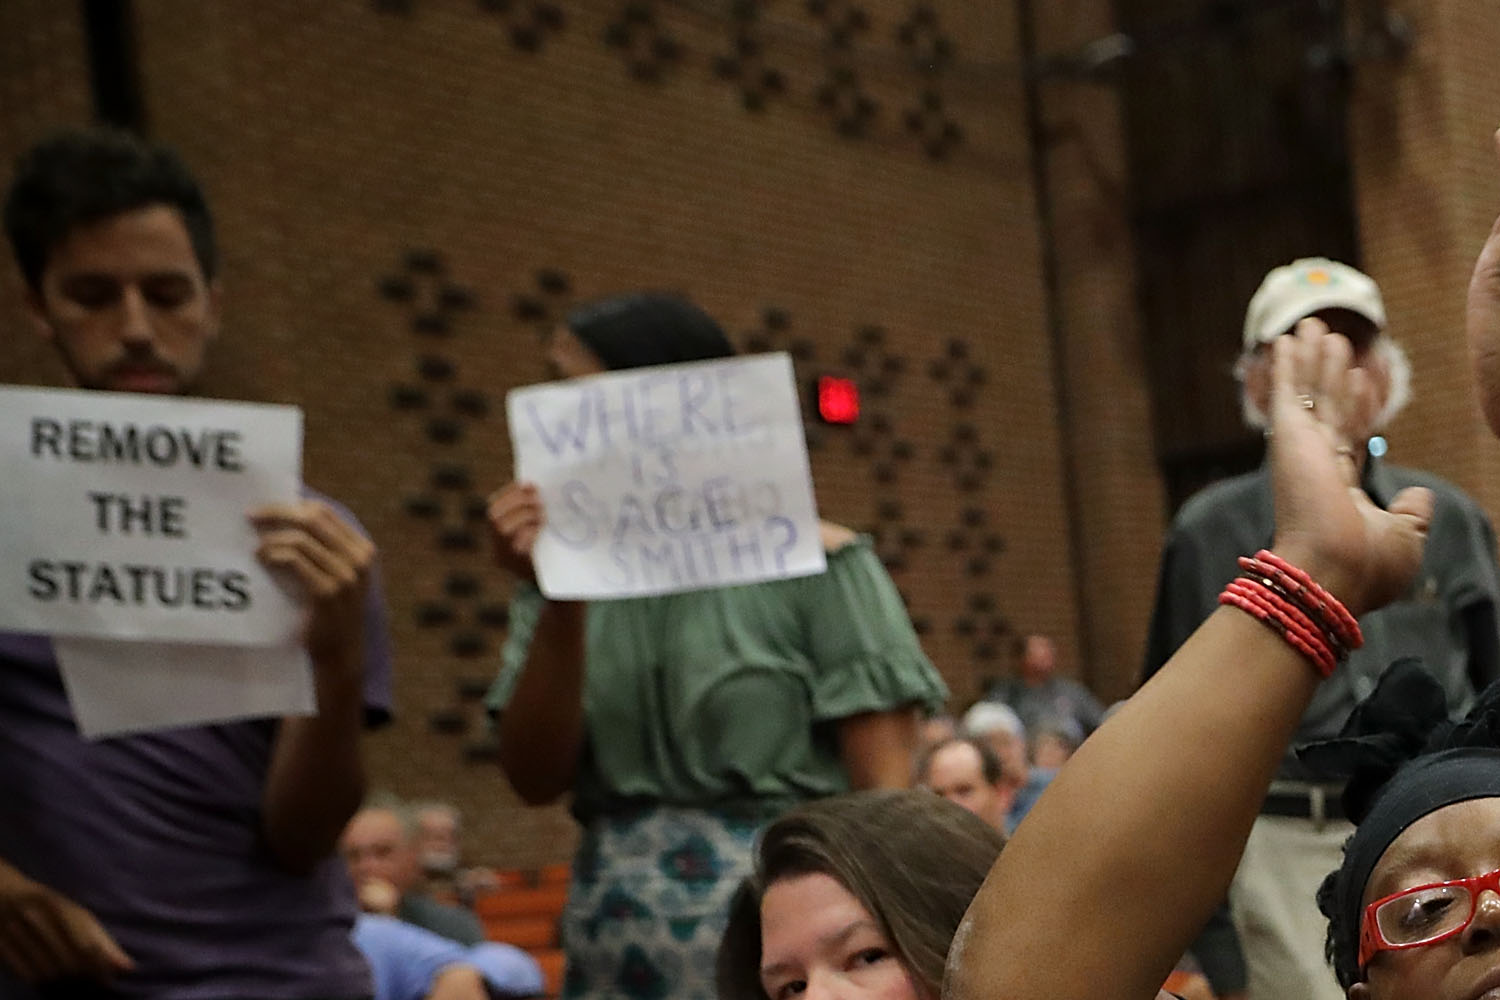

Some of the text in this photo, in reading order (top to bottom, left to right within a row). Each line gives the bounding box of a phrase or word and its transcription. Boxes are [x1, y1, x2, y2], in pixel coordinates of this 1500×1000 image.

[526, 366, 764, 456] WHERE
[31, 417, 244, 473] REMOVE
[631, 446, 680, 487] IS
[88, 490, 188, 539] THE
[27, 559, 252, 612] STATUES
